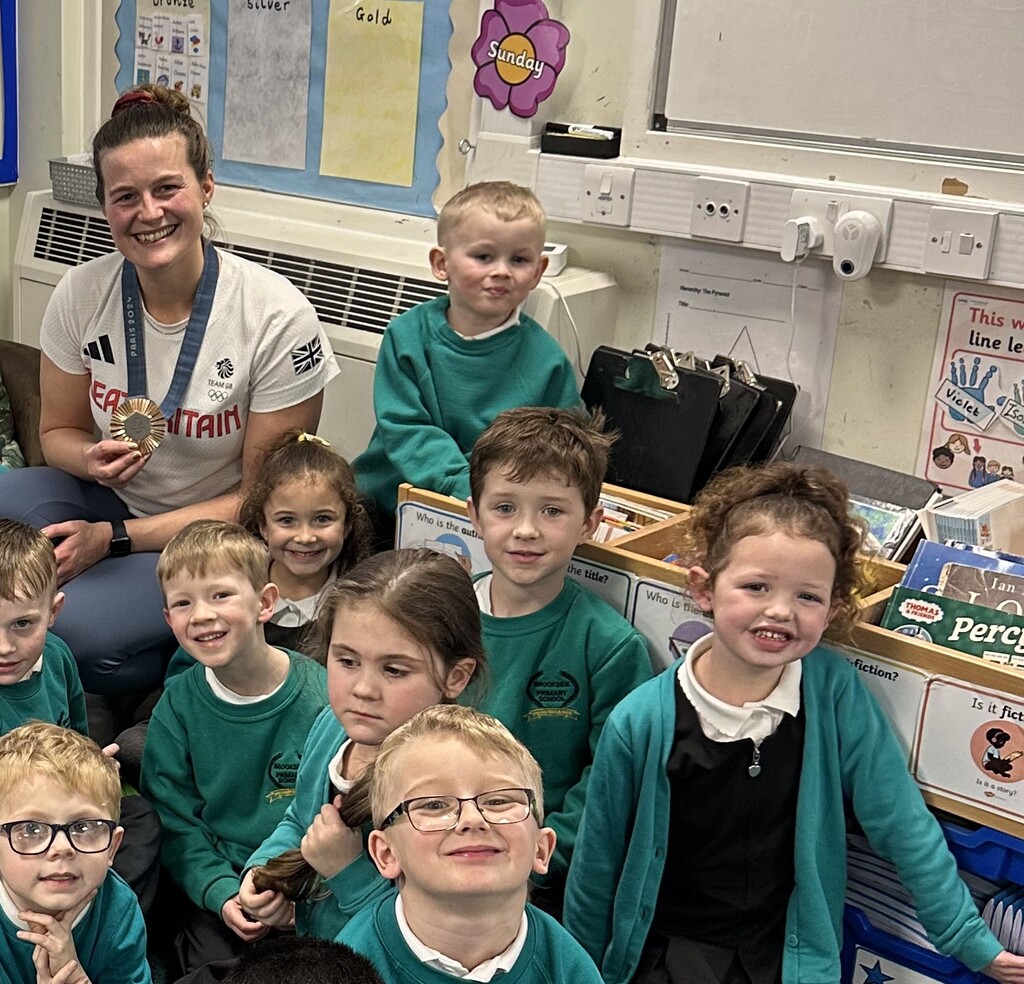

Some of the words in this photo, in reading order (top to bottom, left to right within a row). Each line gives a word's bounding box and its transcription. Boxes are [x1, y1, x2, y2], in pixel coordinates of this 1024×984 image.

[356, 7, 392, 26] Gold
[487, 40, 544, 78] Sunday
[127, 297, 135, 325] 2024
[970, 307, 1004, 328] This
[130, 328, 138, 356] PARIS
[968, 330, 1002, 350] line
[208, 378, 225, 390] TEAM
[946, 388, 980, 416] Violet
[1004, 403, 1024, 424] Iso
[416, 511, 435, 526] Who
[436, 516, 444, 528] is
[446, 519, 460, 532] the
[461, 526, 484, 541] aut
[567, 565, 582, 578] the
[584, 569, 610, 584] title?
[991, 578, 1016, 593] Ian
[646, 590, 668, 606] Who
[672, 596, 680, 609] is
[905, 602, 940, 616] THOMAS
[911, 610, 935, 620] FRIENDS
[846, 658, 899, 682] -fiction?
[972, 698, 984, 710] Is
[988, 702, 997, 714] it
[999, 705, 1024, 721] fict
[976, 778, 982, 786] Is
[984, 780, 989, 788] it
[997, 786, 1018, 796] story?
